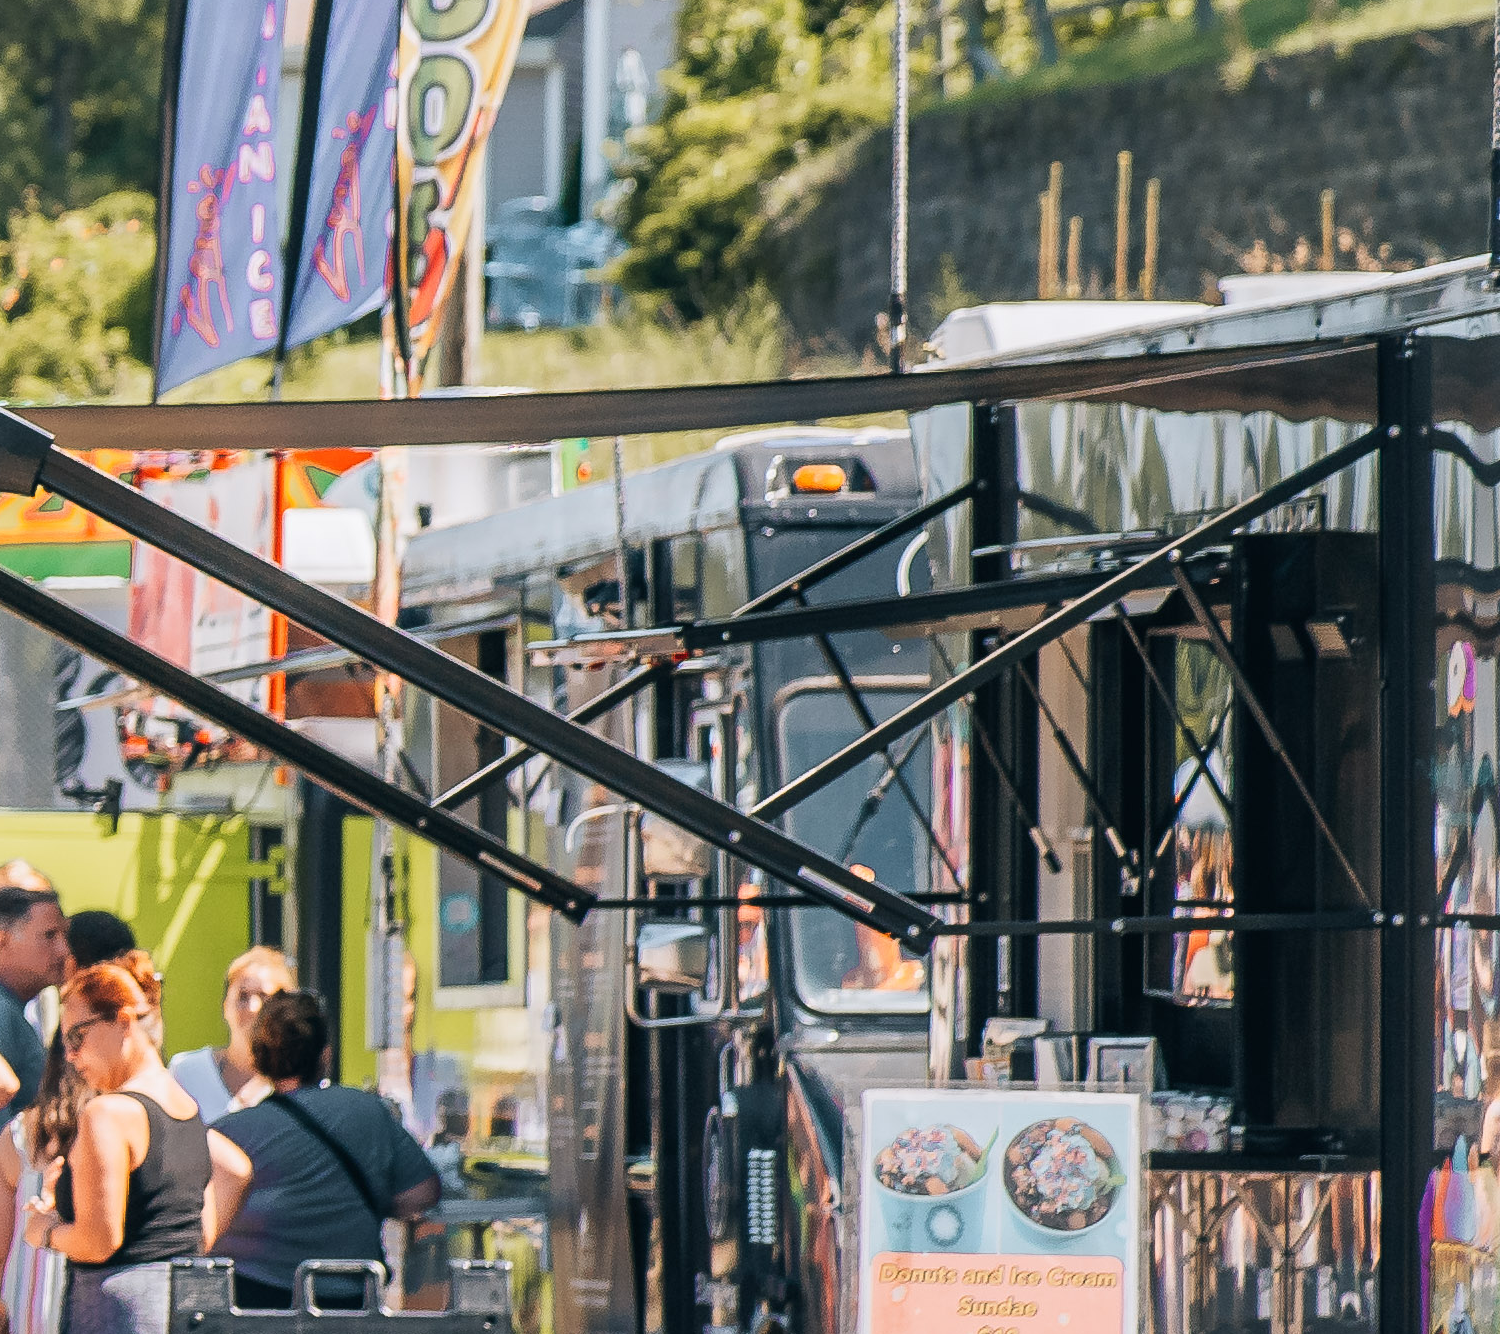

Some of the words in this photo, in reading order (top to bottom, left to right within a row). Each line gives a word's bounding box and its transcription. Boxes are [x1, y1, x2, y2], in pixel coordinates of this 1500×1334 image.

[247, 203, 277, 341] ICE
[879, 1263, 957, 1285] Donuts
[962, 1265, 1004, 1286] and
[1009, 1268, 1041, 1286] Ice
[1046, 1268, 1117, 1288] Cream
[957, 1295, 1038, 1317] Sundae
